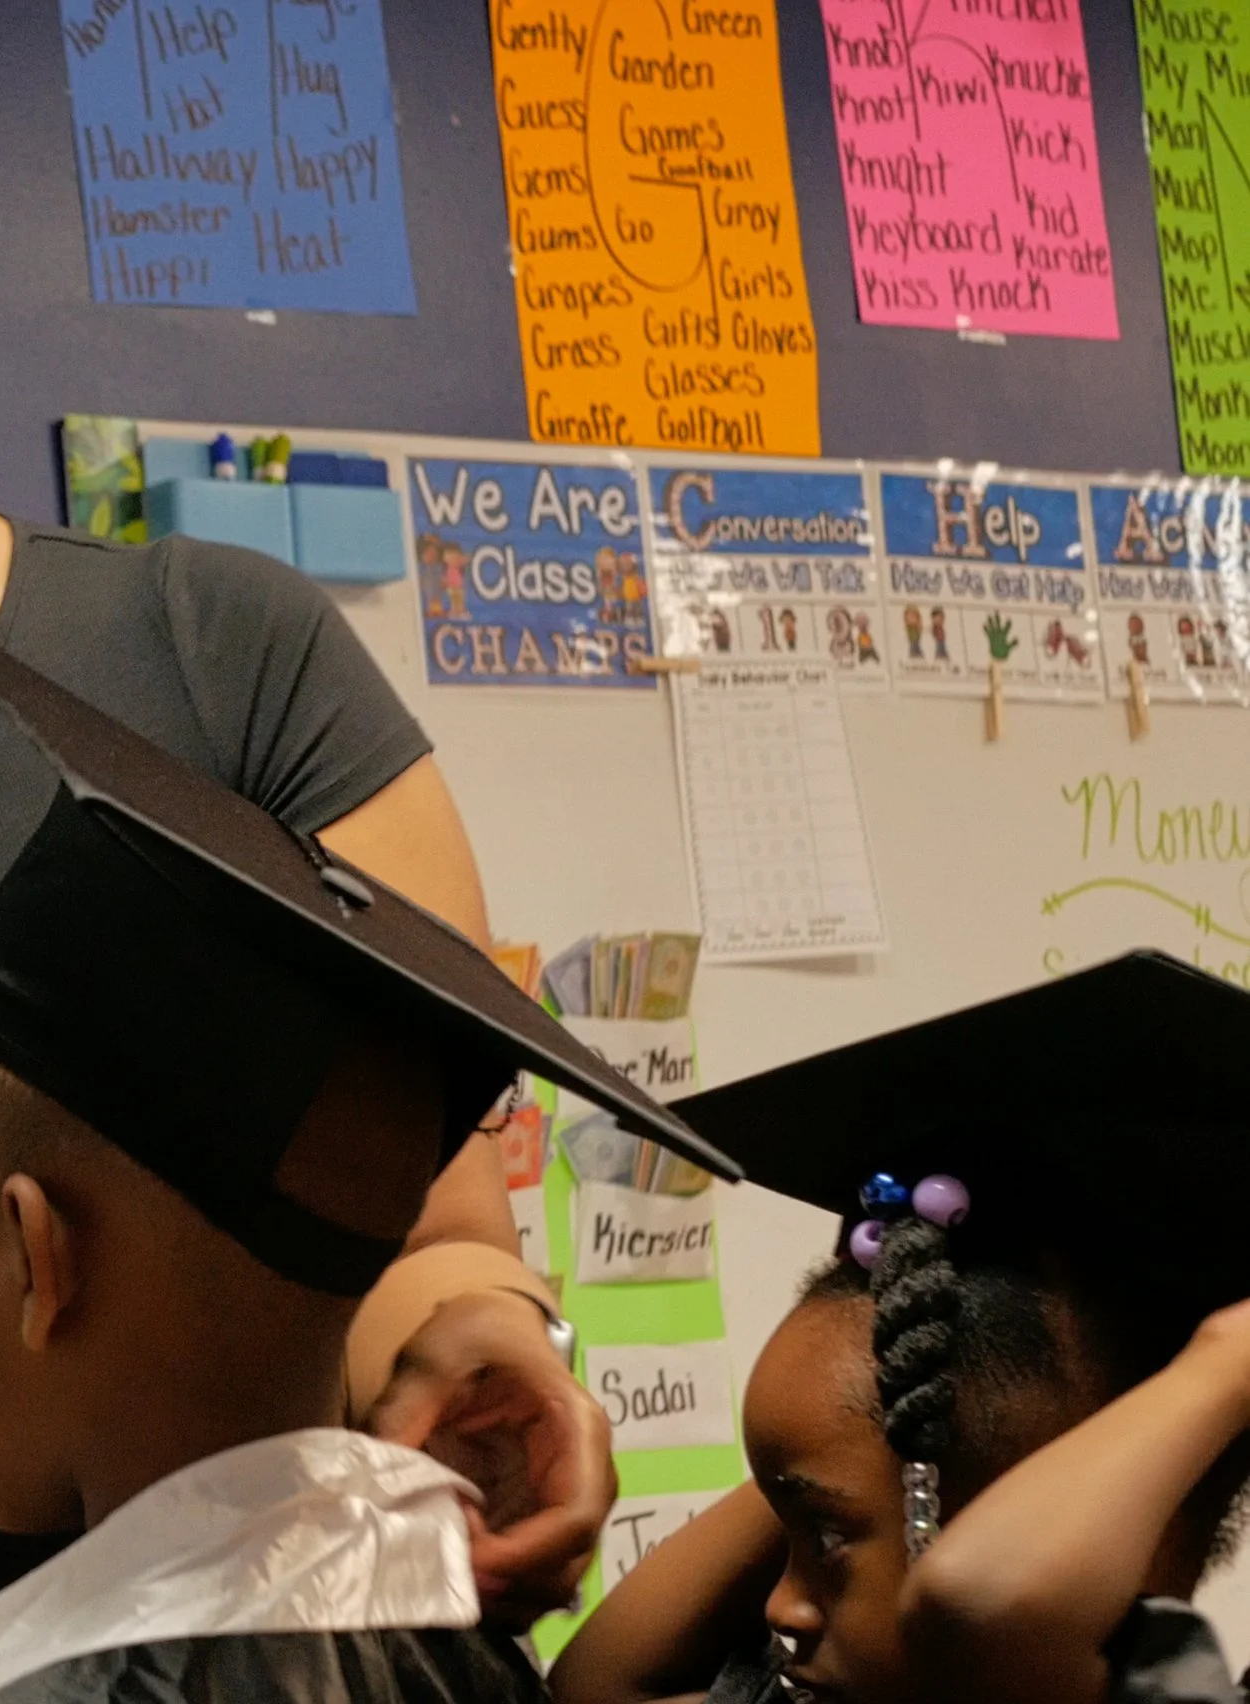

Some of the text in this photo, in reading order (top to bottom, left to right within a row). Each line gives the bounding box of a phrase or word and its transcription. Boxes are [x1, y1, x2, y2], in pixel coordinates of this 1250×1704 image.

[148, 4, 238, 64] Help
[682, 0, 762, 39] Green
[609, 30, 715, 91] Garden
[1143, 43, 1250, 112] My Mi
[276, 43, 349, 138] Hug
[500, 75, 587, 132] Guess
[619, 102, 725, 155] Games
[84, 125, 258, 203] Hallway
[273, 133, 379, 208] Happy
[253, 207, 352, 275] Heat
[516, 208, 599, 255] Gums
[615, 203, 654, 245] Go
[522, 264, 633, 321] Grapes
[718, 259, 793, 302] Girls
[530, 322, 621, 370] Grass
[732, 309, 812, 357] Gloves
[1172, 317, 1250, 366] Muscl
[644, 355, 765, 400] Glasses
[536, 389, 634, 446] Giraffe
[414, 462, 634, 537] We Are
[925, 478, 1042, 563] Help
[470, 544, 599, 605] Class
